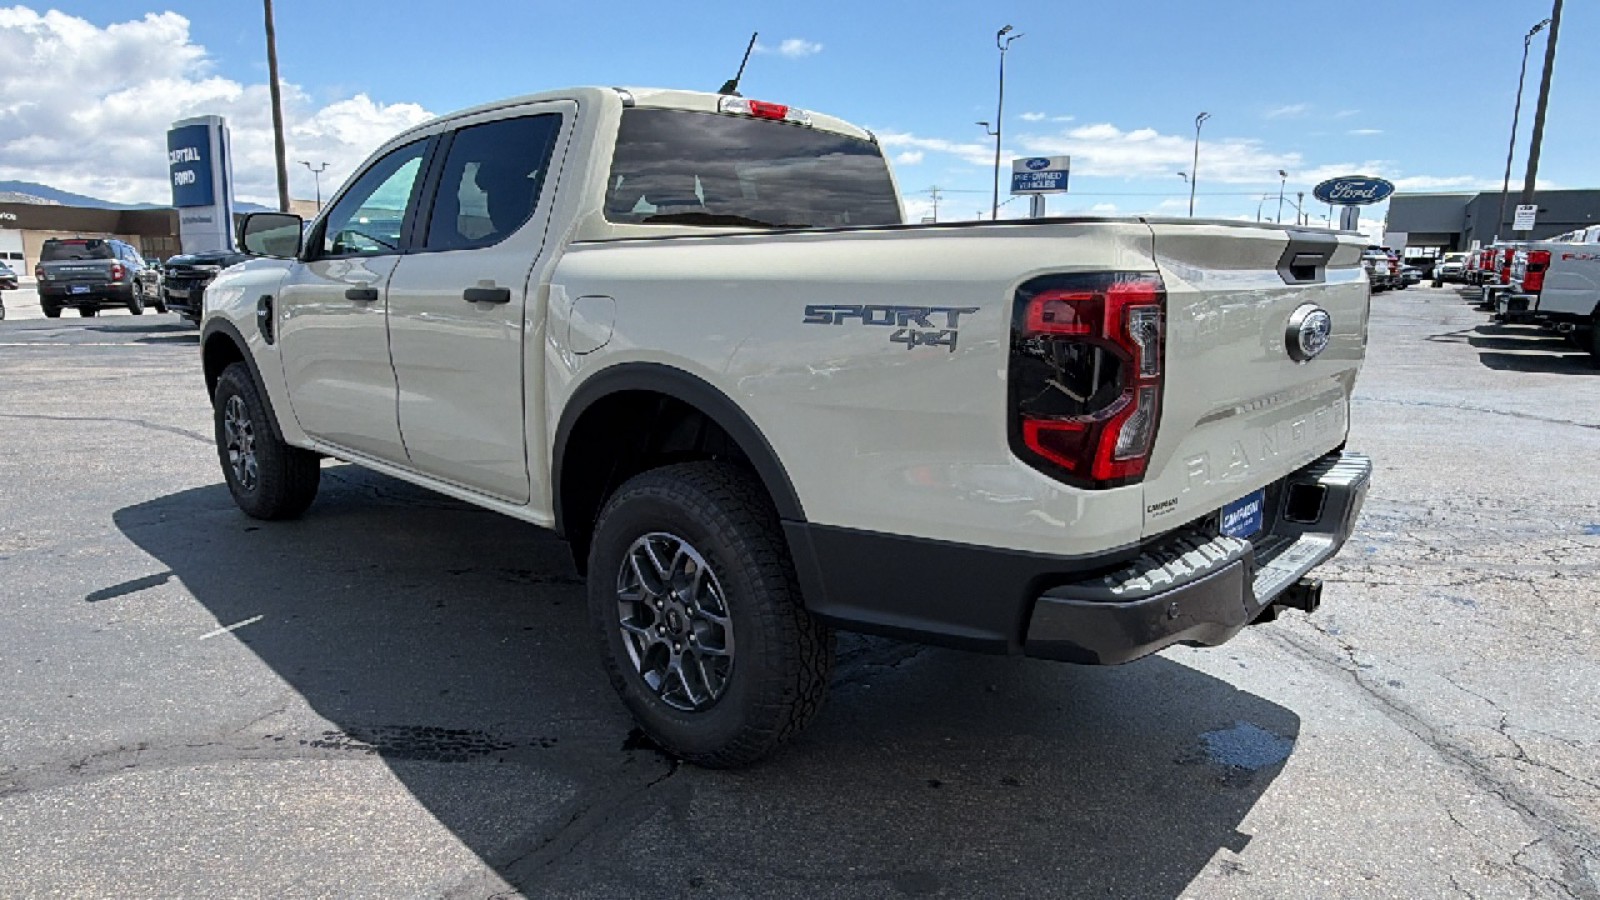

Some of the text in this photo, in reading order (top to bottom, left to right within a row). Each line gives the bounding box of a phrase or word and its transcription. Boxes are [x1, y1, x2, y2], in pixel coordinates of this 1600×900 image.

[169, 147, 200, 165] CAPITAL
[174, 170, 195, 186] FORD
[1014, 172, 1062, 181] PRE-OWNED
[1019, 180, 1056, 190] VEHICLES
[1329, 182, 1378, 199] Ford
[802, 305, 981, 328] SPORT
[889, 329, 958, 353] 4x4
[1182, 399, 1346, 493] RANGER
